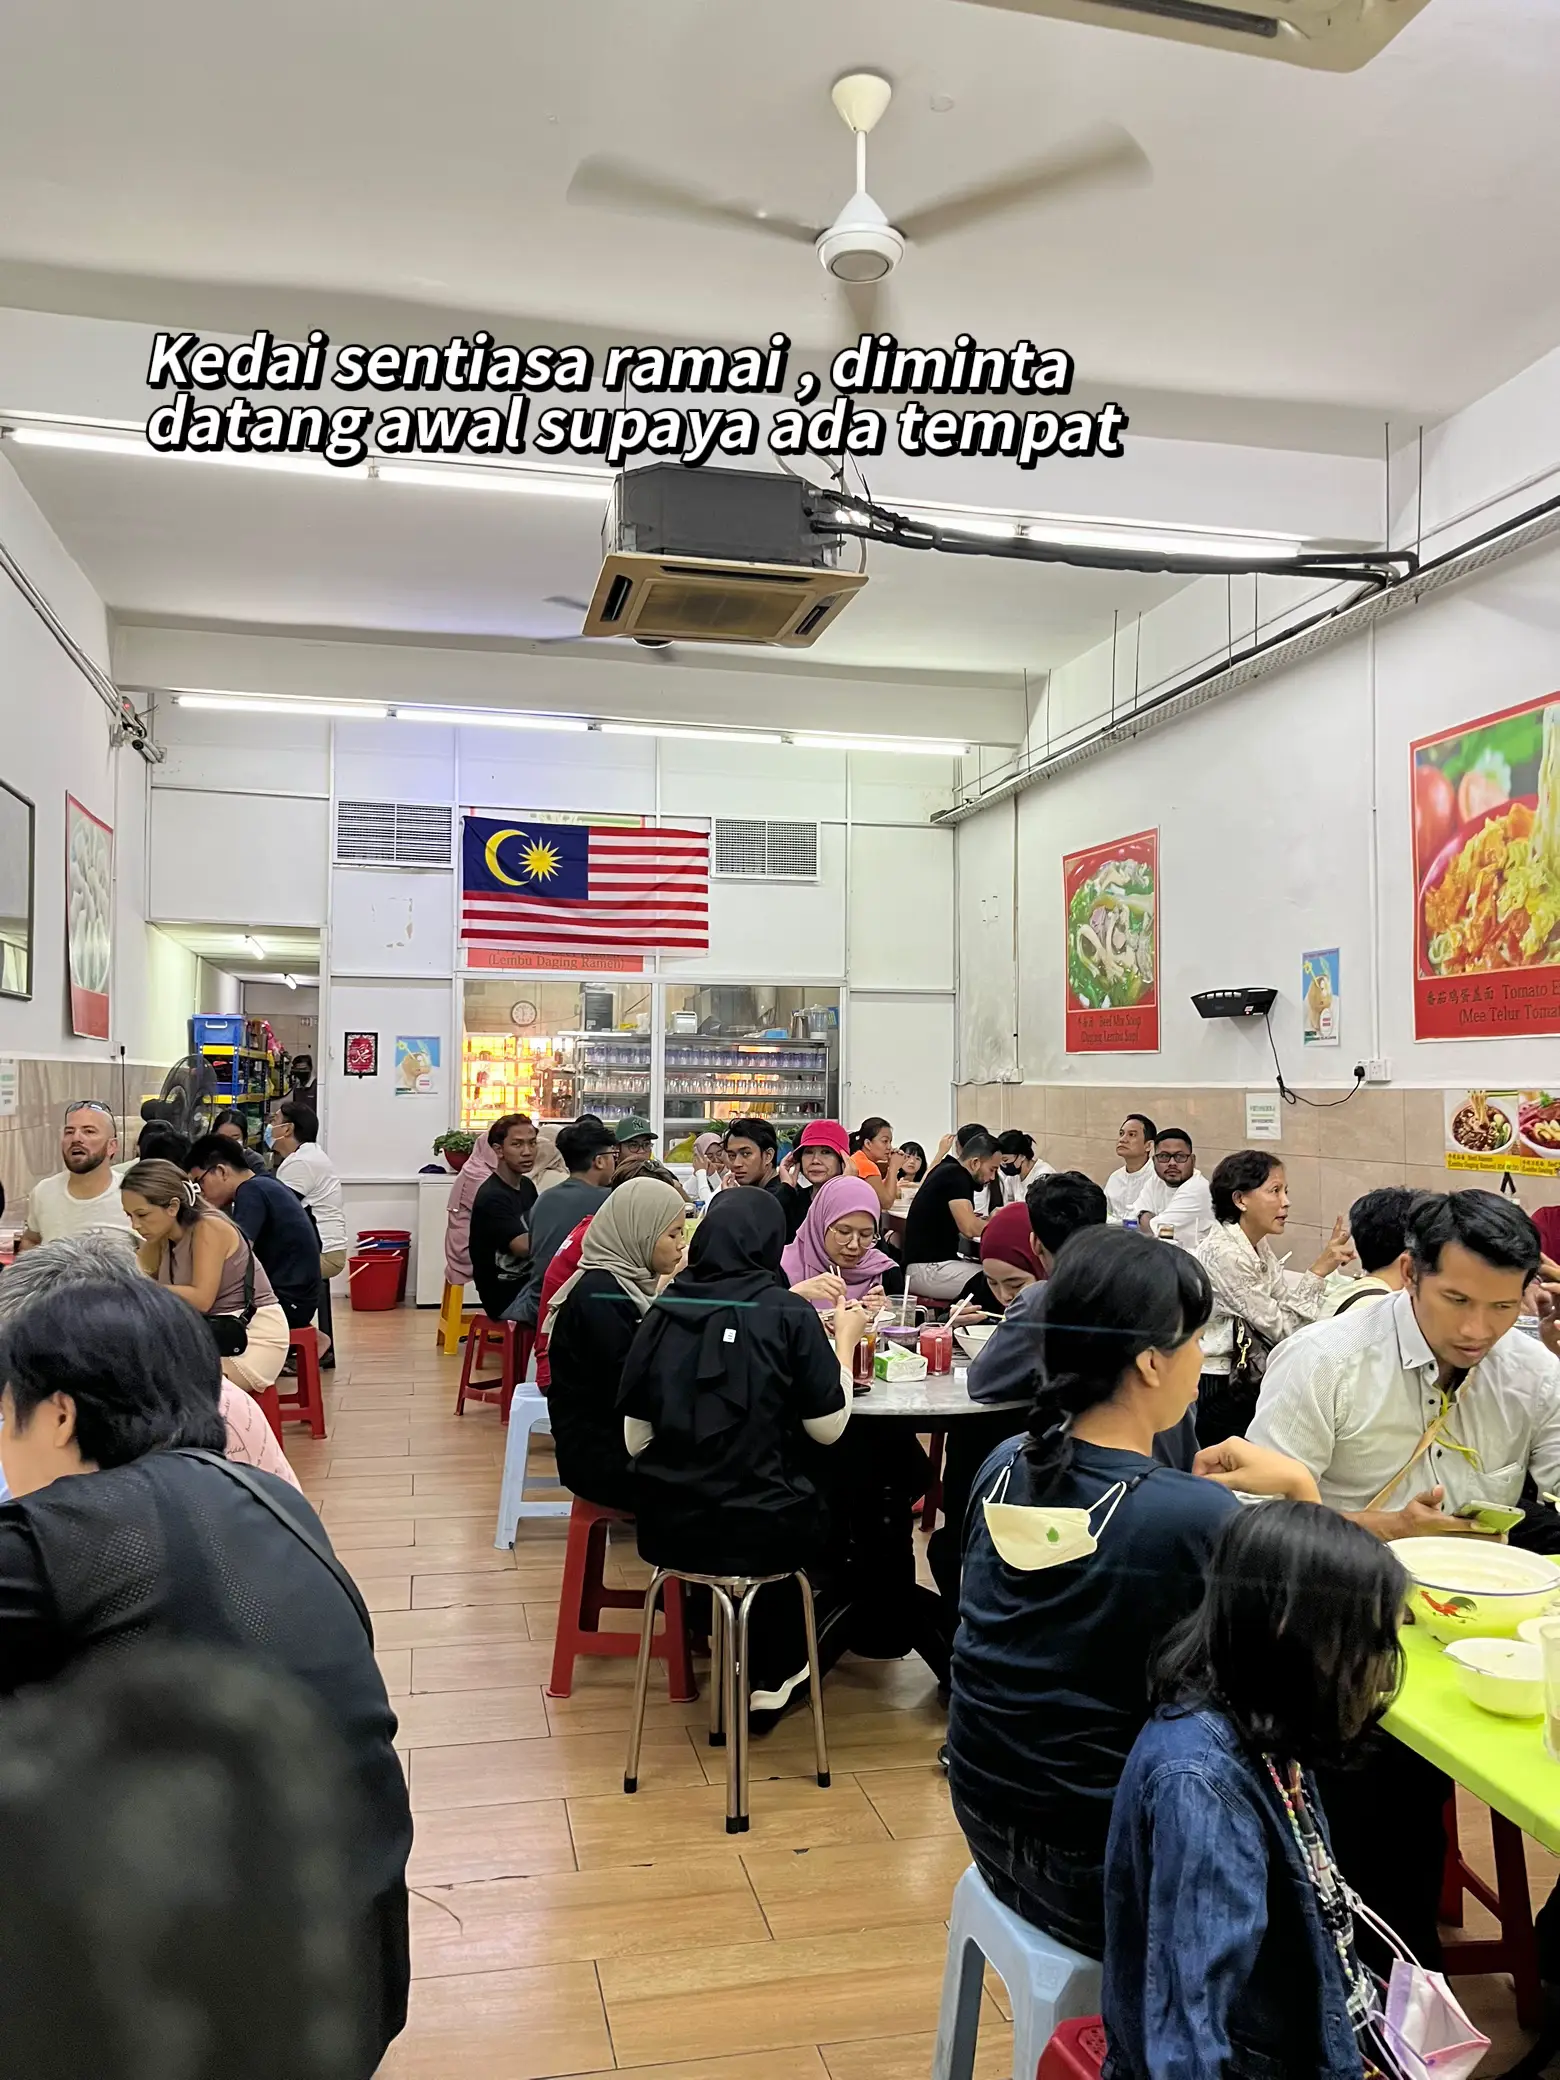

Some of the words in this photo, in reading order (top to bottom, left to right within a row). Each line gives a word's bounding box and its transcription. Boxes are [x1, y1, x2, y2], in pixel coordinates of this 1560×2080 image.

[488, 952, 533, 966] (Lembu
[536, 955, 578, 969] Daging
[582, 956, 624, 970] Ramen)
[1502, 983, 1548, 1000] Tomato
[1459, 1007, 1486, 1025] (Mee
[1489, 1005, 1520, 1022] Telur
